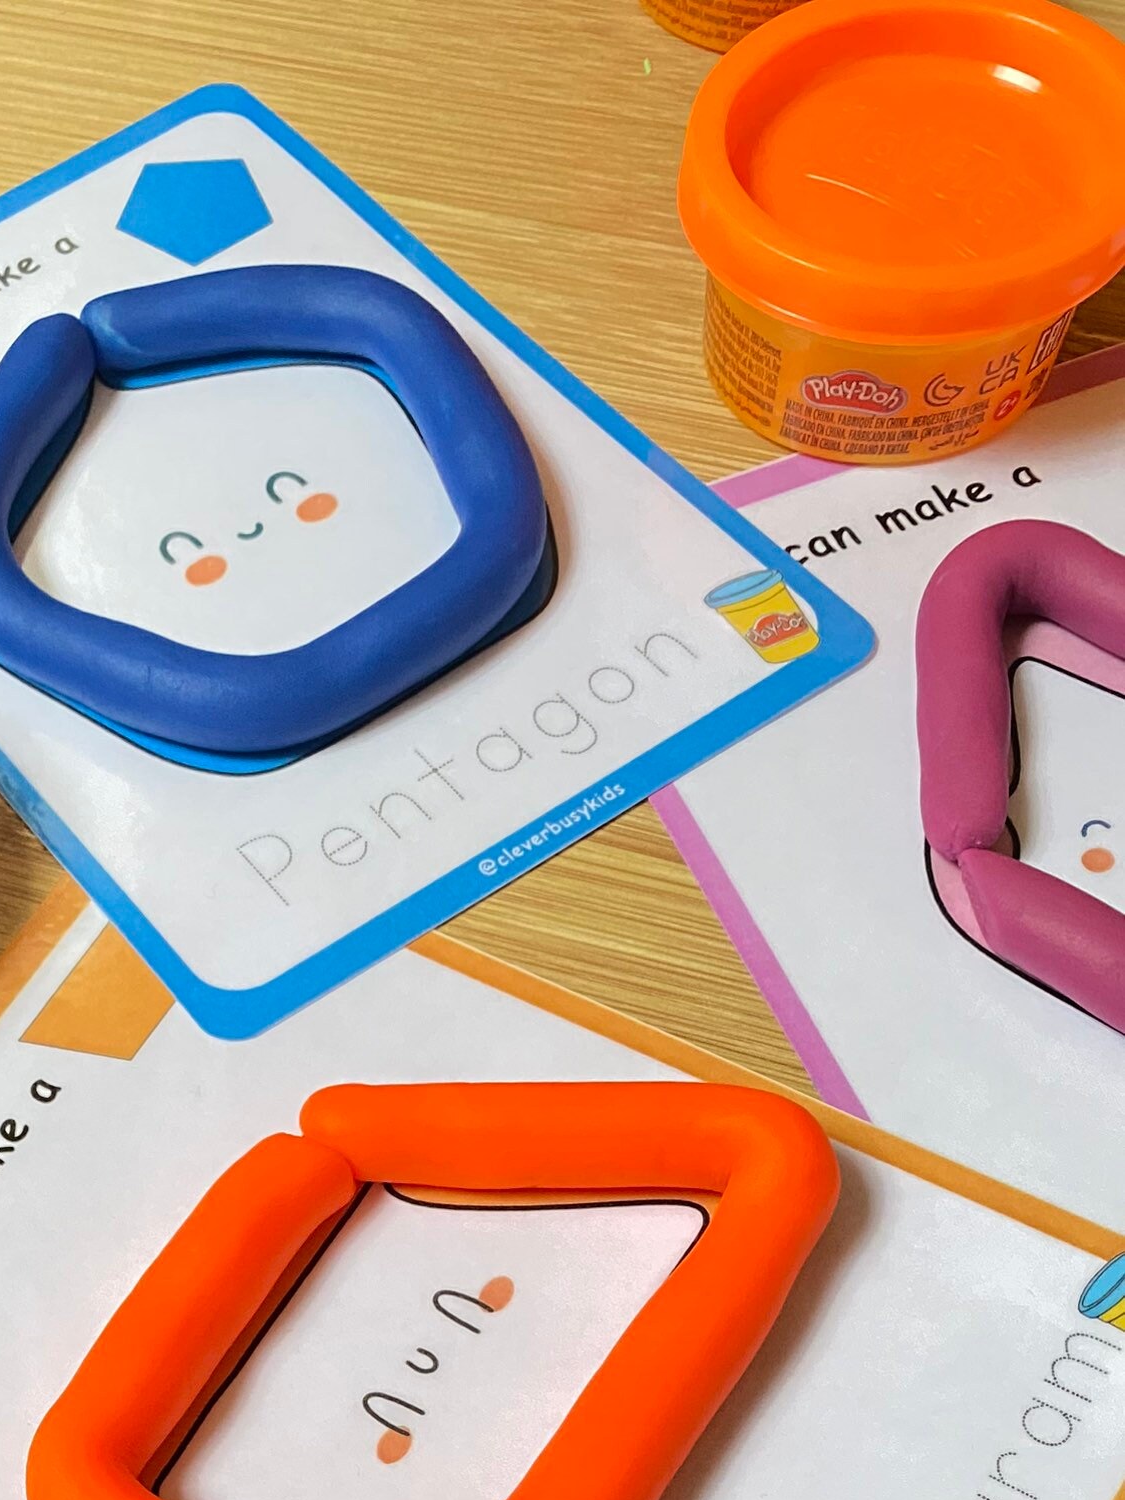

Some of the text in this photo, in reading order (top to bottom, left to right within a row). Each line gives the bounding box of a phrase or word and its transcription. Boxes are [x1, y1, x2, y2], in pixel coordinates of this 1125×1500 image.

[54, 237, 79, 255] a
[806, 376, 900, 410] Play-Doh
[785, 466, 1043, 565] can make a
[237, 633, 699, 906] Pentagon
[478, 783, 626, 876] @cleverbusykids
[30, 1079, 62, 1104] a
